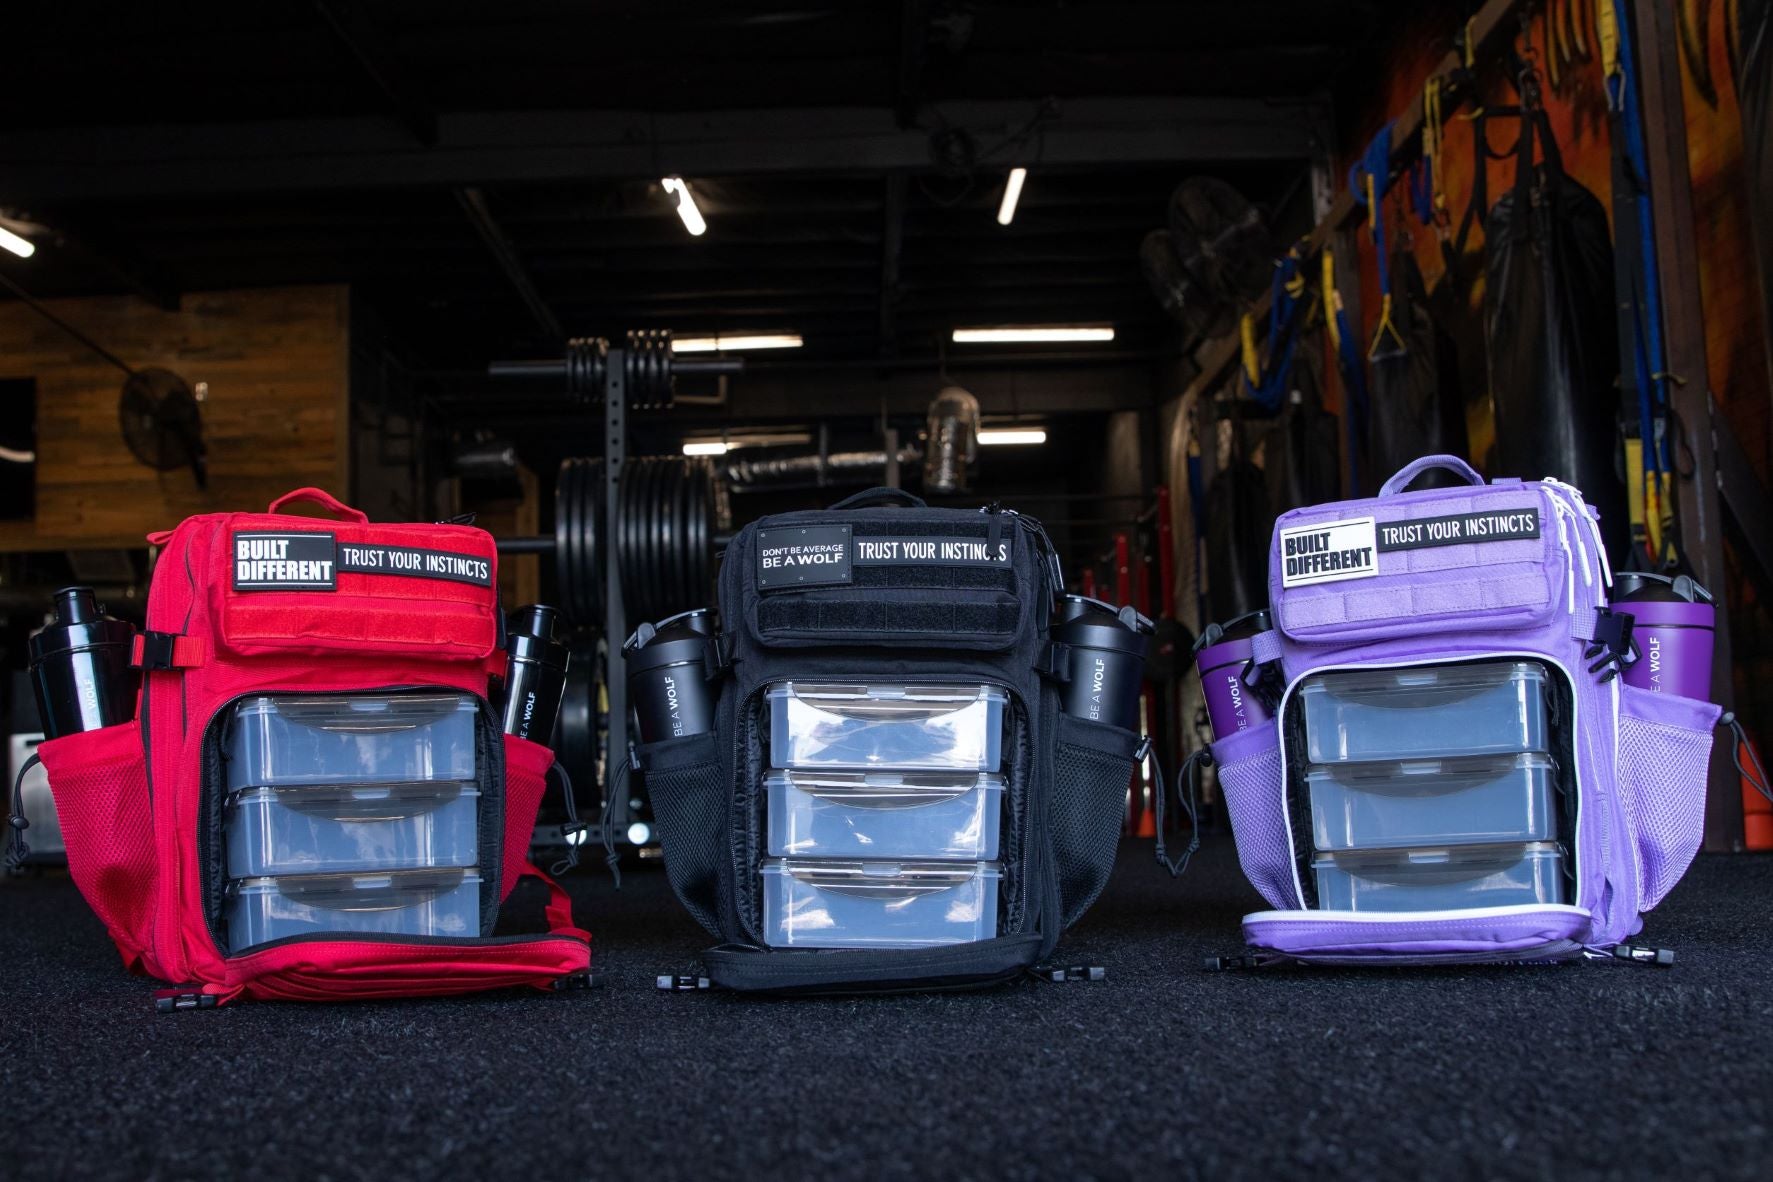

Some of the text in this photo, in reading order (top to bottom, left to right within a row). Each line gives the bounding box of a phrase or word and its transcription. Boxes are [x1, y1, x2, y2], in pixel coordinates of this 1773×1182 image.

[1382, 513, 1534, 545] TRUST YOUR INSTINCTS
[237, 540, 289, 560] BUILT
[762, 543, 844, 557] DON'T BE AVERAGE
[858, 542, 1007, 562] TRUST YOUR INSTINCS
[1284, 531, 1331, 557] BUILT
[237, 560, 333, 581] DIFFERENT
[343, 548, 488, 580] TRUST YOUR INSTINCTS
[762, 552, 844, 569] BE A WOLF
[1286, 546, 1373, 577] DIFFERENT
[1649, 636, 1661, 673] WOLF
[1089, 658, 1105, 720] BE A WOLF
[1228, 675, 1242, 709] WOLF
[1650, 674, 1661, 683] A
[84, 679, 97, 710] WOLF
[523, 691, 536, 720] WOLF
[664, 676, 683, 737] BE A WOLF
[1236, 708, 1244, 717] A
[522, 722, 529, 731] A
